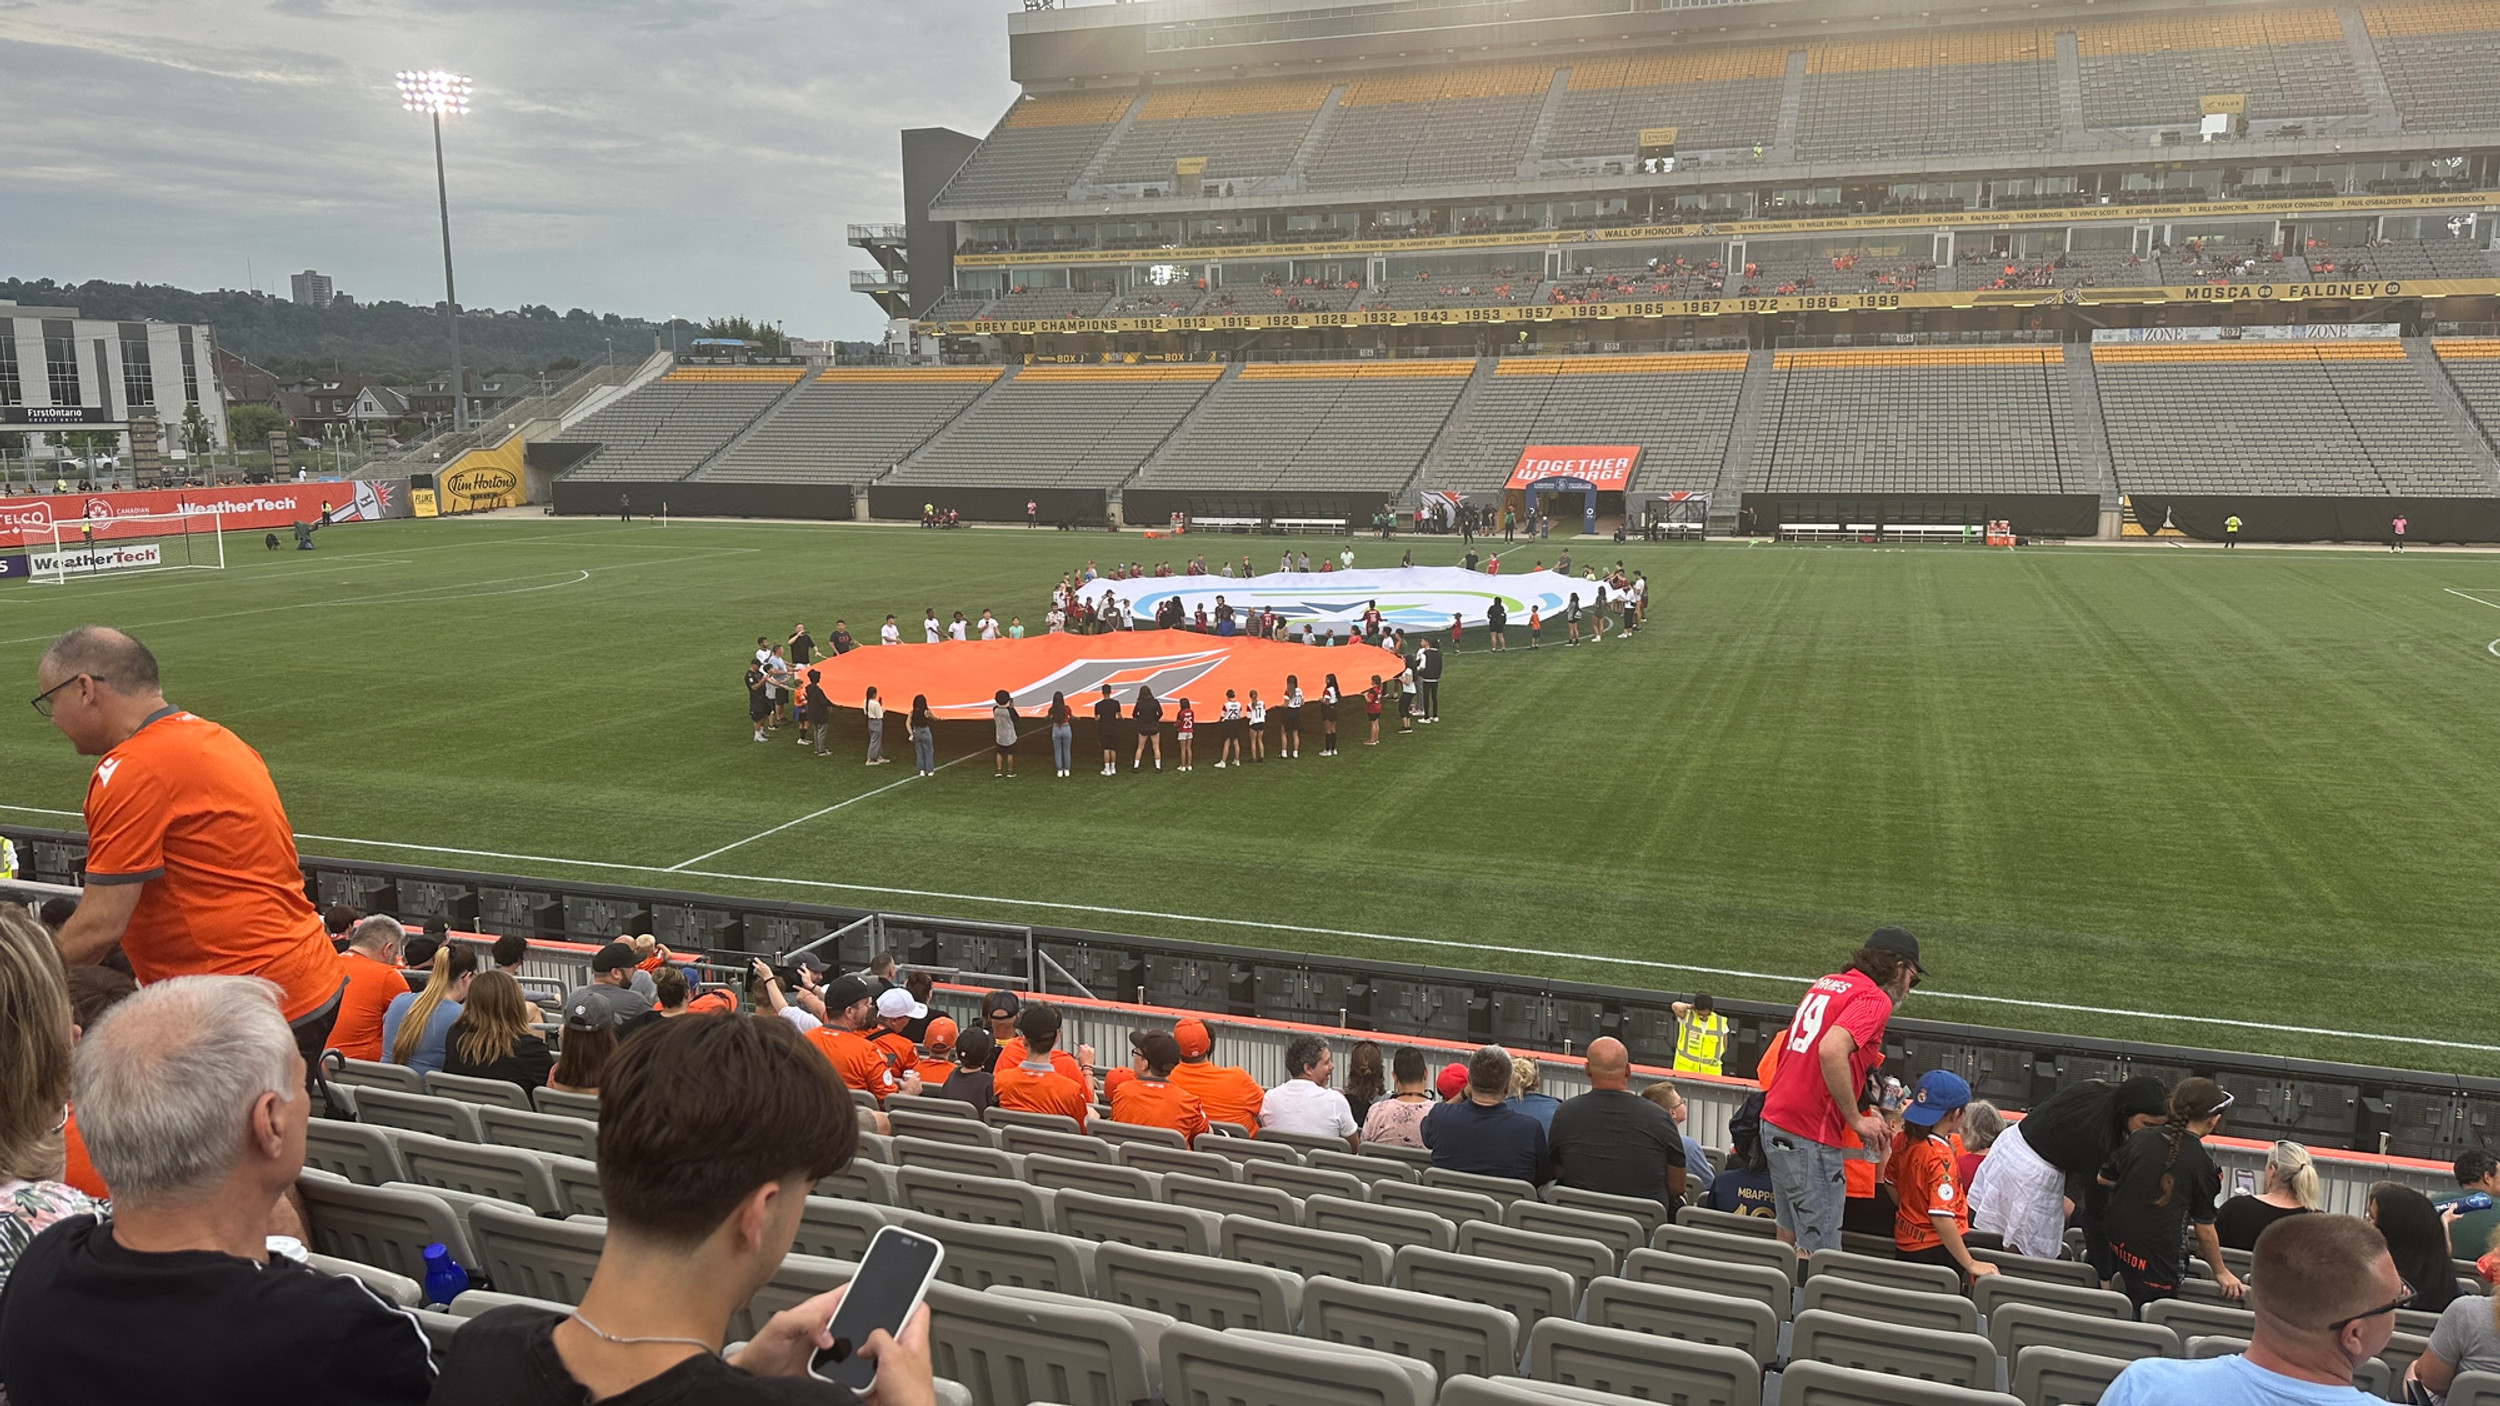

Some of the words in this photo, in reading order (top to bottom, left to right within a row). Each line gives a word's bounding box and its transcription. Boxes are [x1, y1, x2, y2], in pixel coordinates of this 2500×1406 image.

[2294, 200, 2334, 208] COVINGTON
[2365, 198, 2412, 206] OSBALDISTON
[2431, 196, 2445, 204] ROB
[1897, 216, 1920, 224] COFFEY
[1604, 229, 1629, 238] WALL
[1631, 228, 1642, 237] OF
[1644, 227, 1684, 236] HONOUR
[2185, 286, 2251, 300] MOSCA
[2289, 283, 2379, 297] FALONEY
[974, 322, 1006, 332] GREY
[1012, 321, 1036, 331] CUP
[1041, 319, 1118, 330] CHAMPIONS
[1133, 318, 1162, 328] 1912
[1177, 317, 1206, 328] 1913
[1221, 316, 1251, 327] 1915
[1266, 315, 1299, 326] 1928
[1314, 313, 1348, 324] 1929
[1363, 312, 1397, 323] 1932
[1413, 310, 1448, 322] 1943
[1465, 309, 1500, 320] 1953
[1517, 307, 1553, 318] 1957
[1570, 305, 1608, 317] 1963
[1626, 303, 1664, 314] 1965
[1682, 301, 1720, 313] 1967
[1739, 299, 1778, 311] 1972
[1797, 297, 1838, 309] 1986
[1858, 295, 1899, 306] 1999
[2145, 327, 2184, 341] ZONE
[2221, 327, 2238, 336] 107
[2308, 325, 2349, 338] ZONE
[1057, 354, 1076, 363] BOX
[1079, 353, 1084, 362] J
[1164, 352, 1184, 362] BOX
[1188, 352, 1193, 362] J
[27, 408, 82, 417] FirstOntario
[1525, 457, 1630, 472] TOGETHER
[1516, 469, 1552, 480] WE
[451, 474, 472, 491] Tim
[473, 473, 514, 490] Hortons
[415, 494, 434, 502] FLUKE
[177, 497, 296, 514] WeatherTech
[0, 511, 44, 524] ELCO
[34, 549, 156, 570] WeatherTech
[1182, 717, 1193, 728] 25
[1786, 992, 1831, 1054] 19
